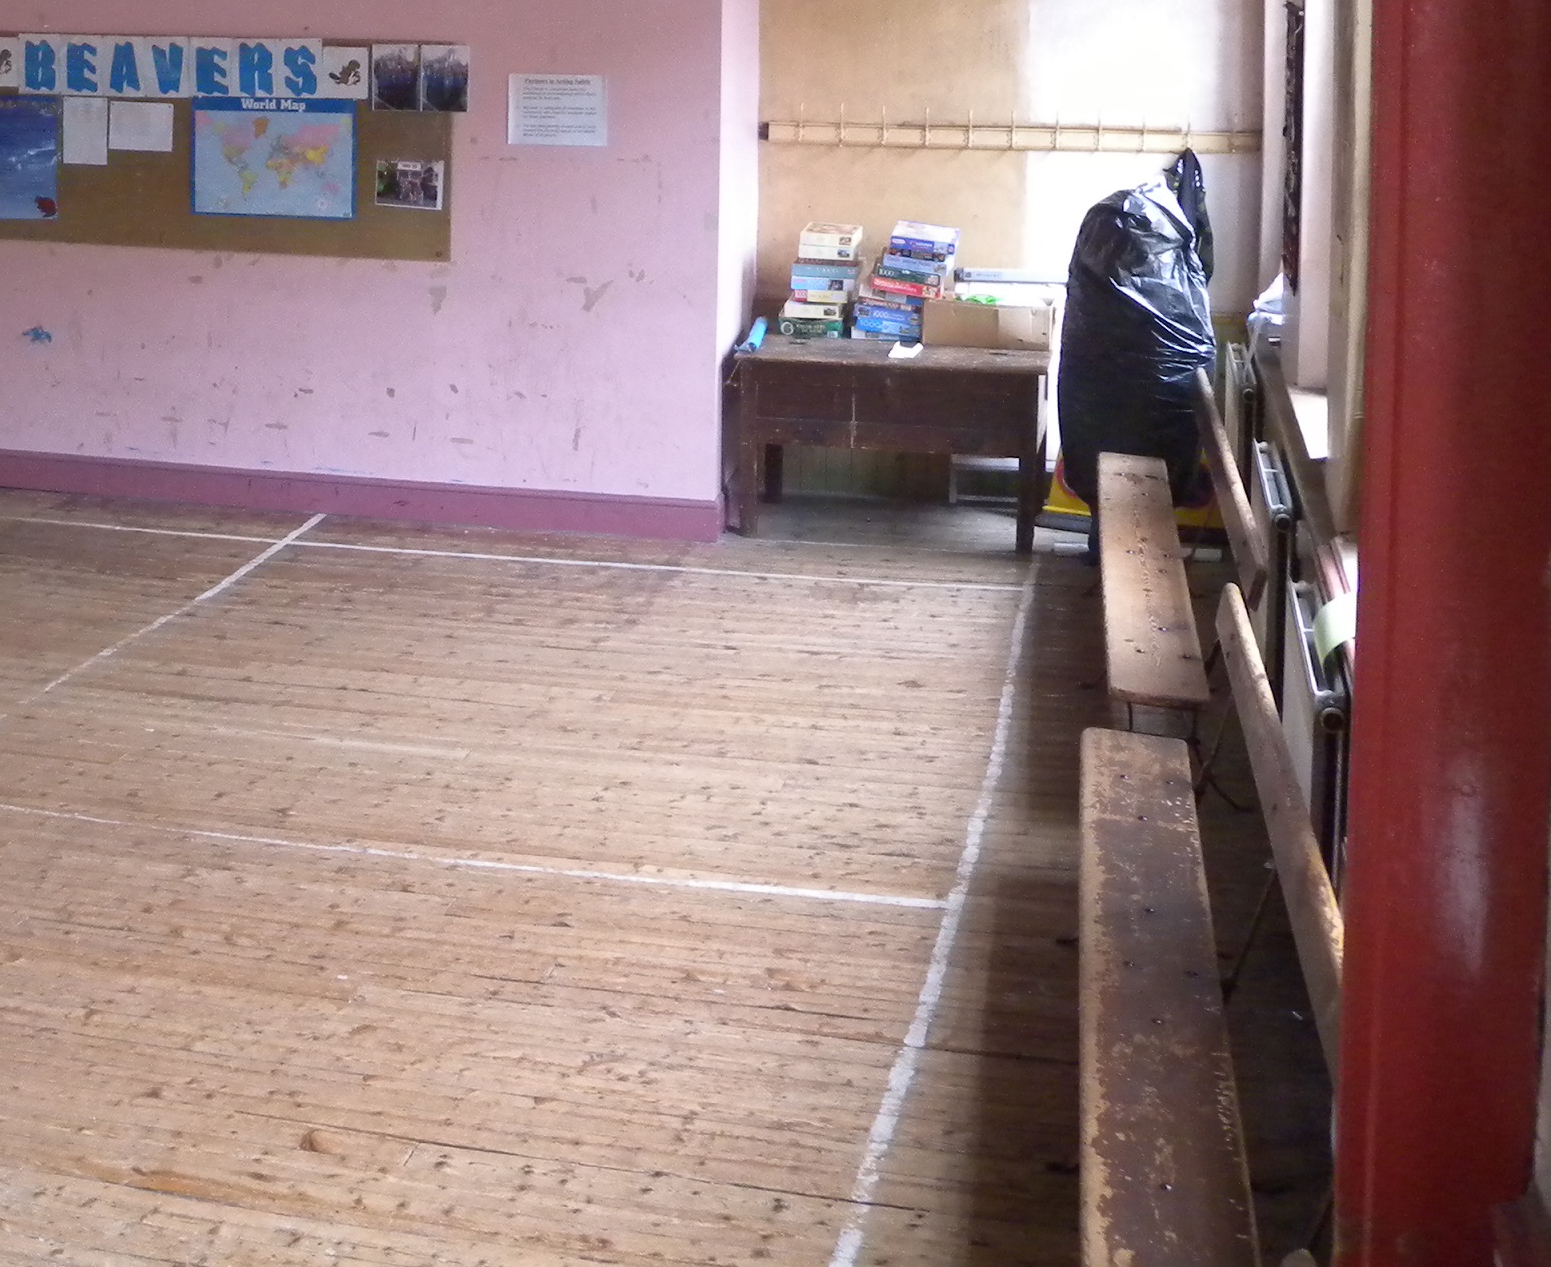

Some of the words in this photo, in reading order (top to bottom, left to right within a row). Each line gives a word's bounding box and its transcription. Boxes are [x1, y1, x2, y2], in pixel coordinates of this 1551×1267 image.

[24, 39, 317, 96] BEAVERS
[240, 98, 277, 110] World
[280, 99, 307, 112] Map
